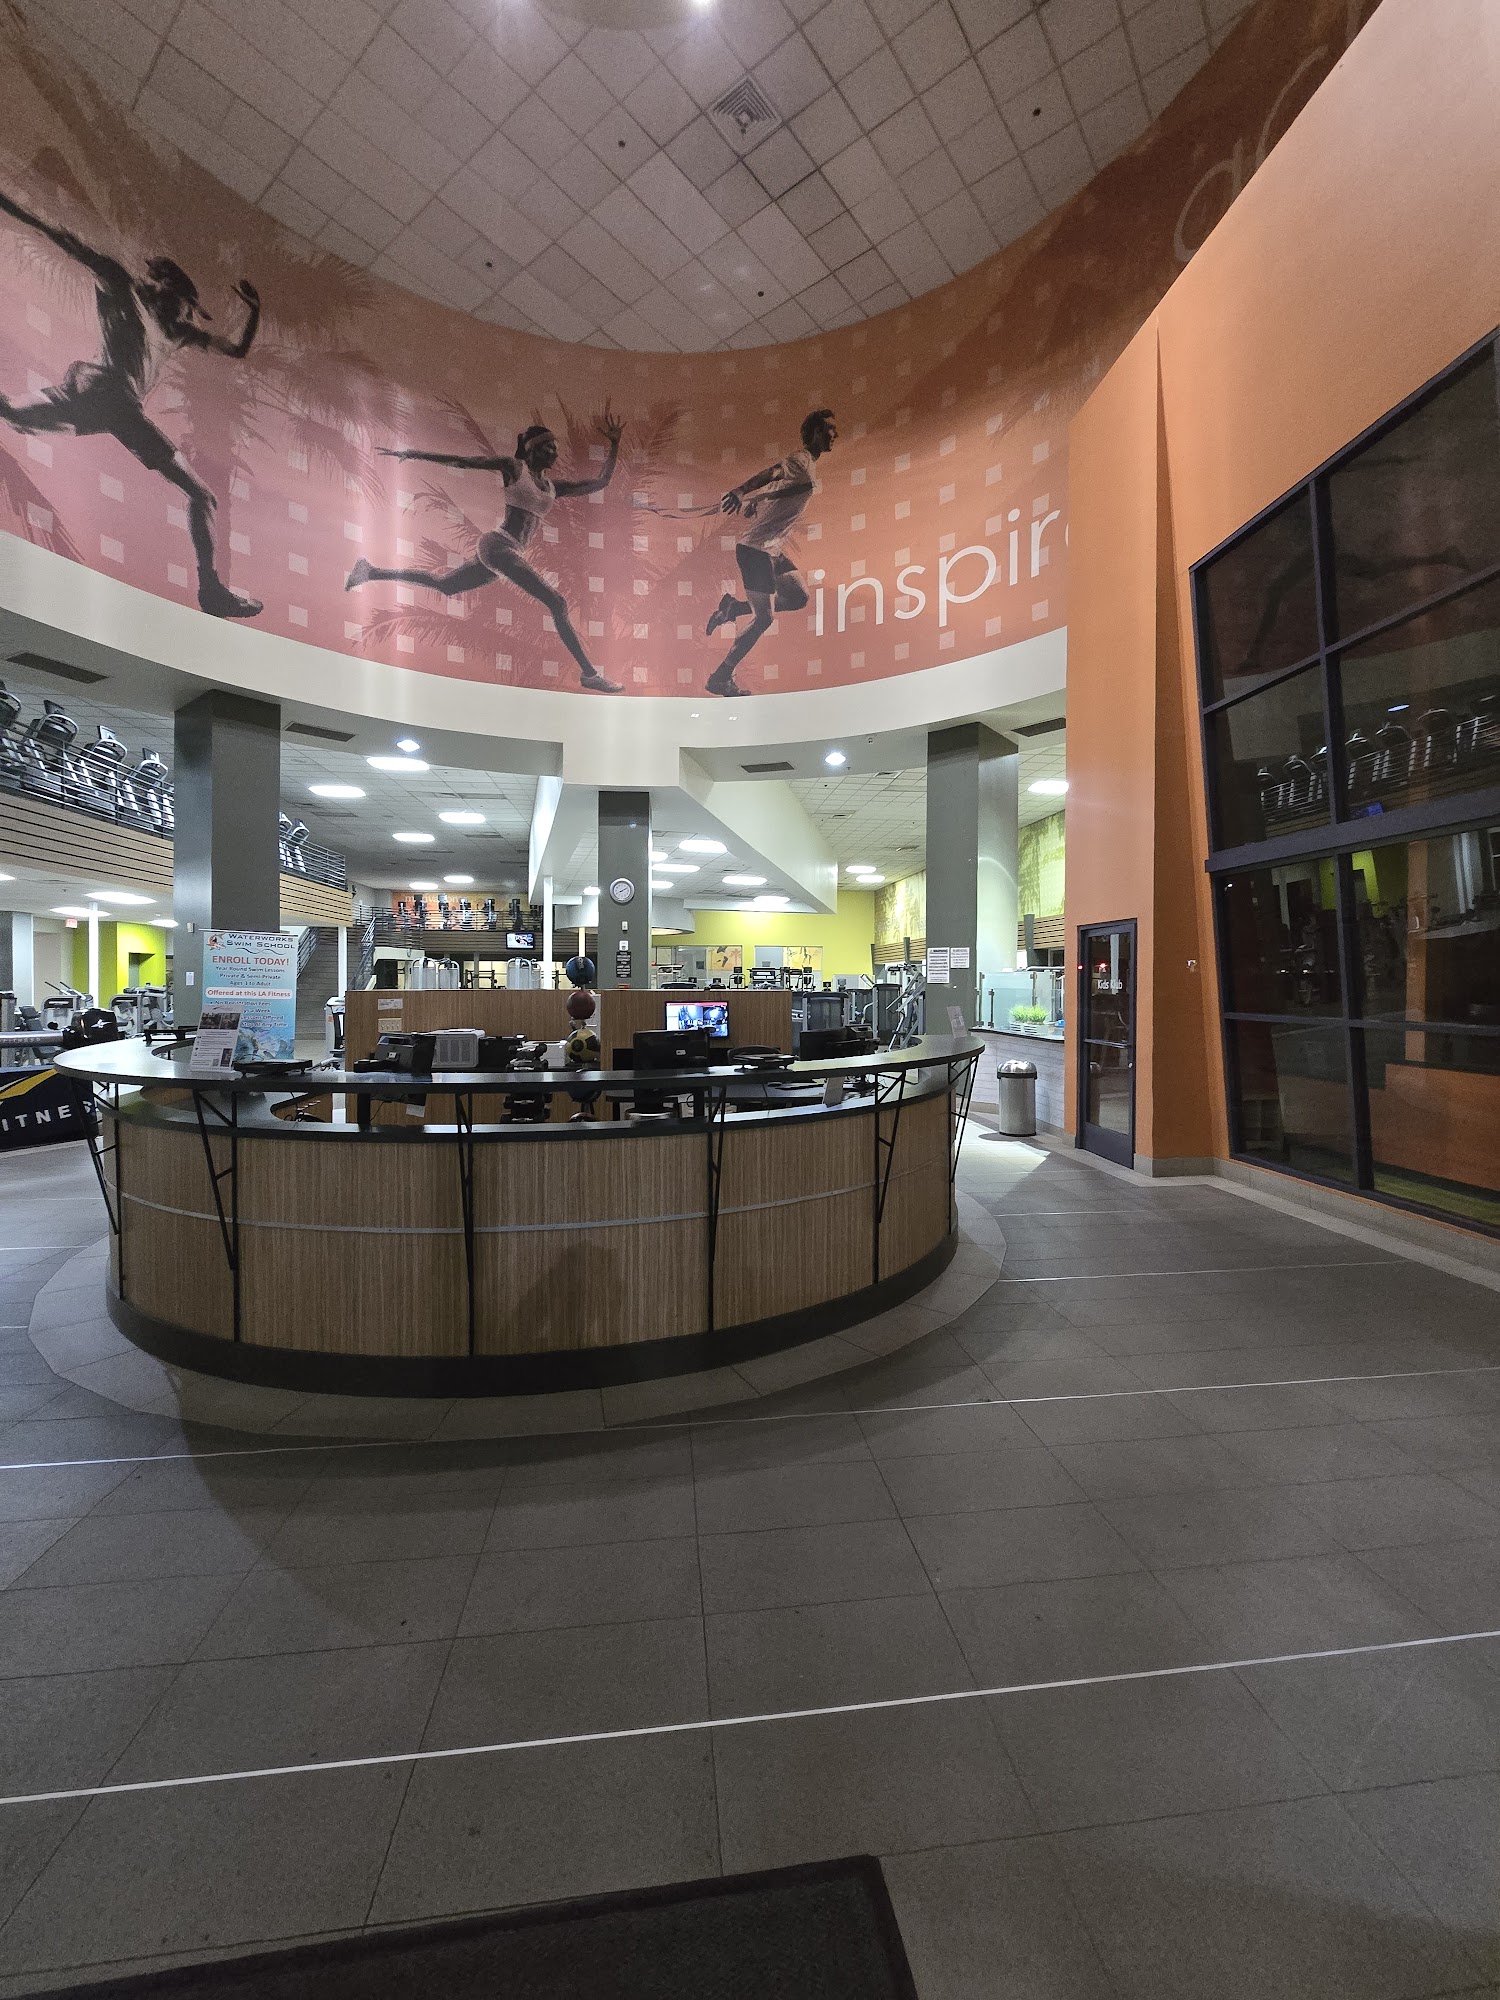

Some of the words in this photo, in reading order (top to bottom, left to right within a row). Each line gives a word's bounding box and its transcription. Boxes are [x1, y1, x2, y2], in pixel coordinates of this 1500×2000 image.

[815, 508, 1068, 636] inspir
[228, 933, 294, 942] WATERWORKS
[256, 941, 295, 949] SCHOOL
[212, 955, 251, 965] ENROLL
[253, 957, 289, 966] TODAY!
[1097, 979, 1110, 989] Kids
